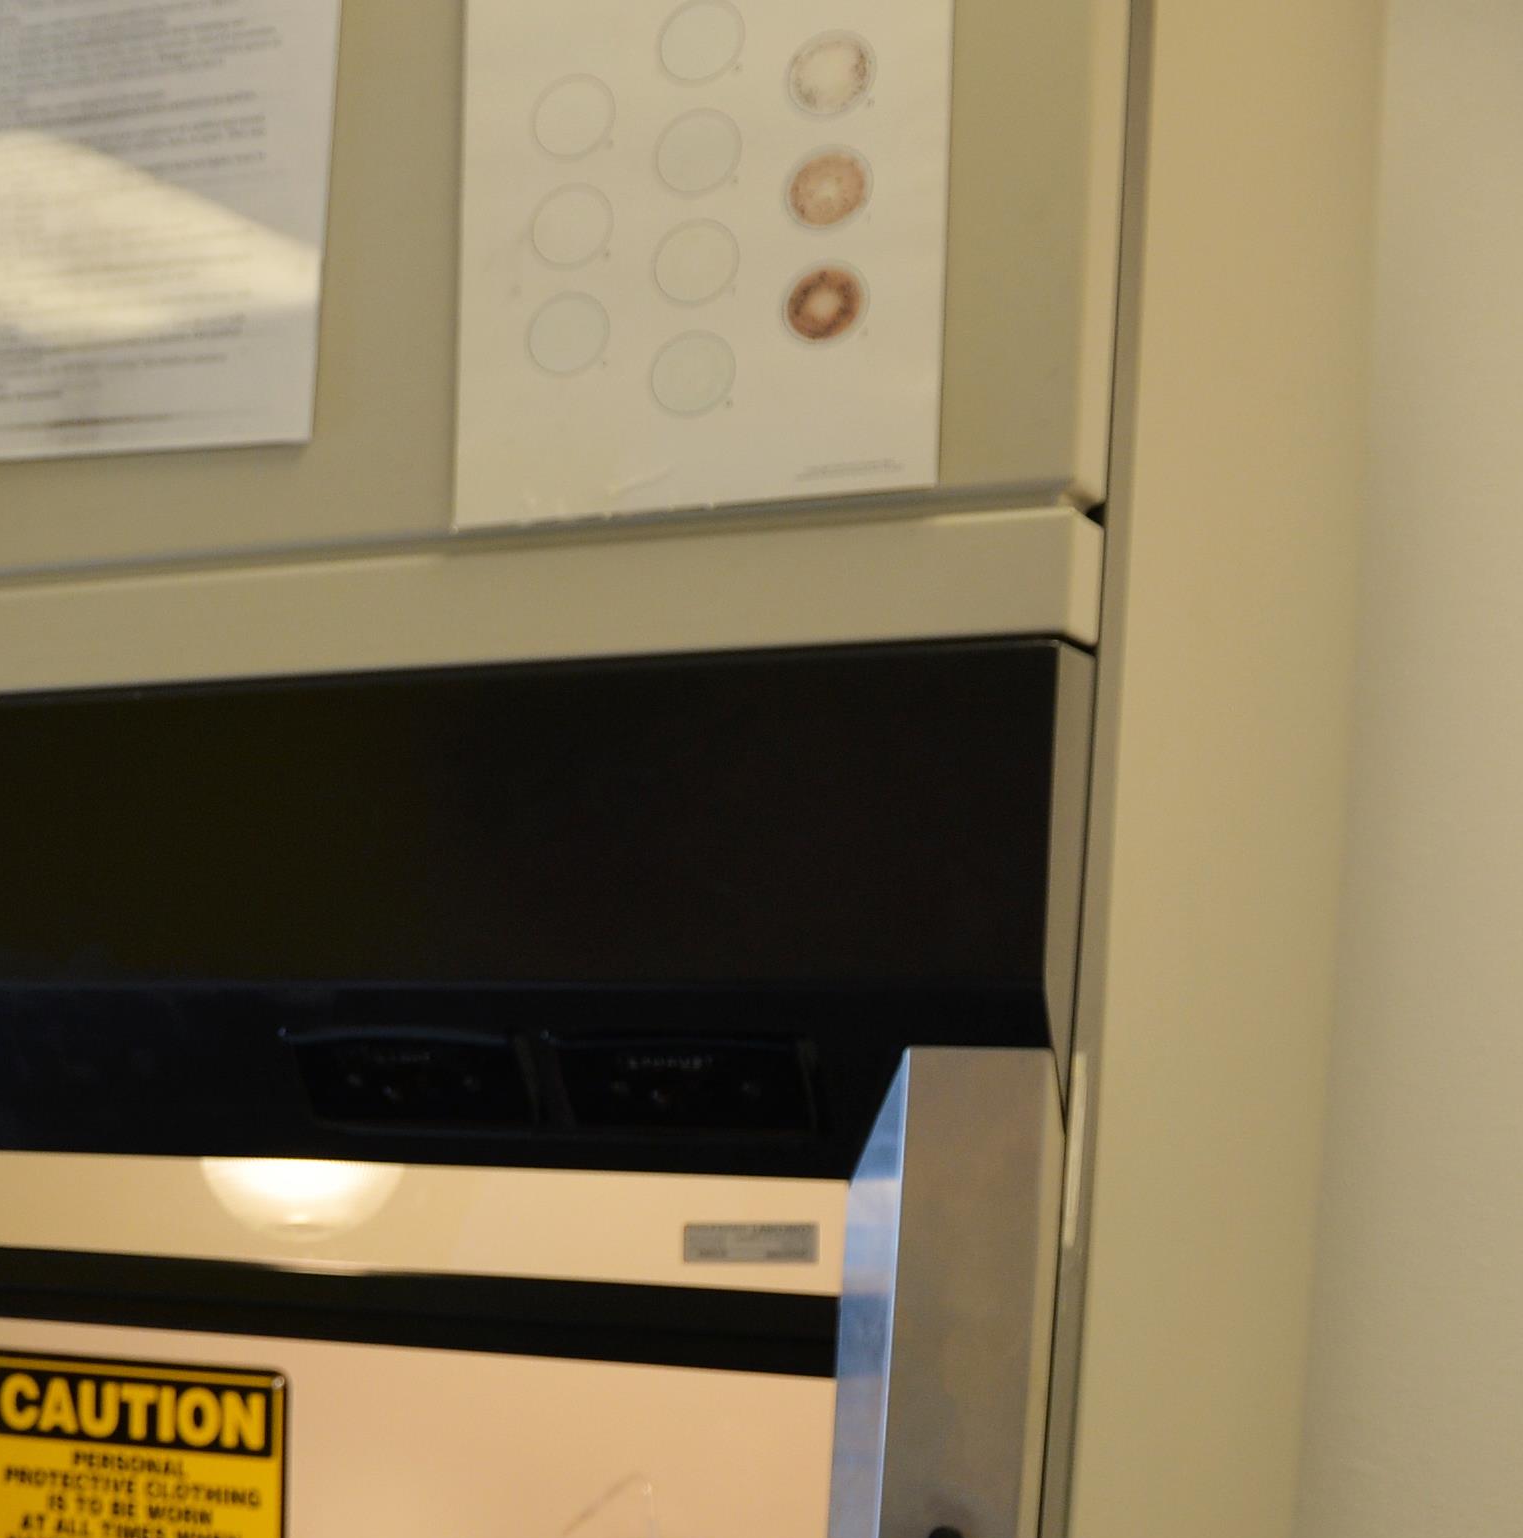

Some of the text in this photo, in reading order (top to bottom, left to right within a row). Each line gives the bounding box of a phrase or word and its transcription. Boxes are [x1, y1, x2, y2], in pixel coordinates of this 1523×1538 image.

[74, 1451, 184, 1477] PERSONAL
[5, 1466, 261, 1508] PROTECTIVE CLOTHING
[49, 1495, 213, 1526] IS TO BE WORN
[21, 1513, 46, 1531] AT
[56, 1517, 89, 1537] ALL
